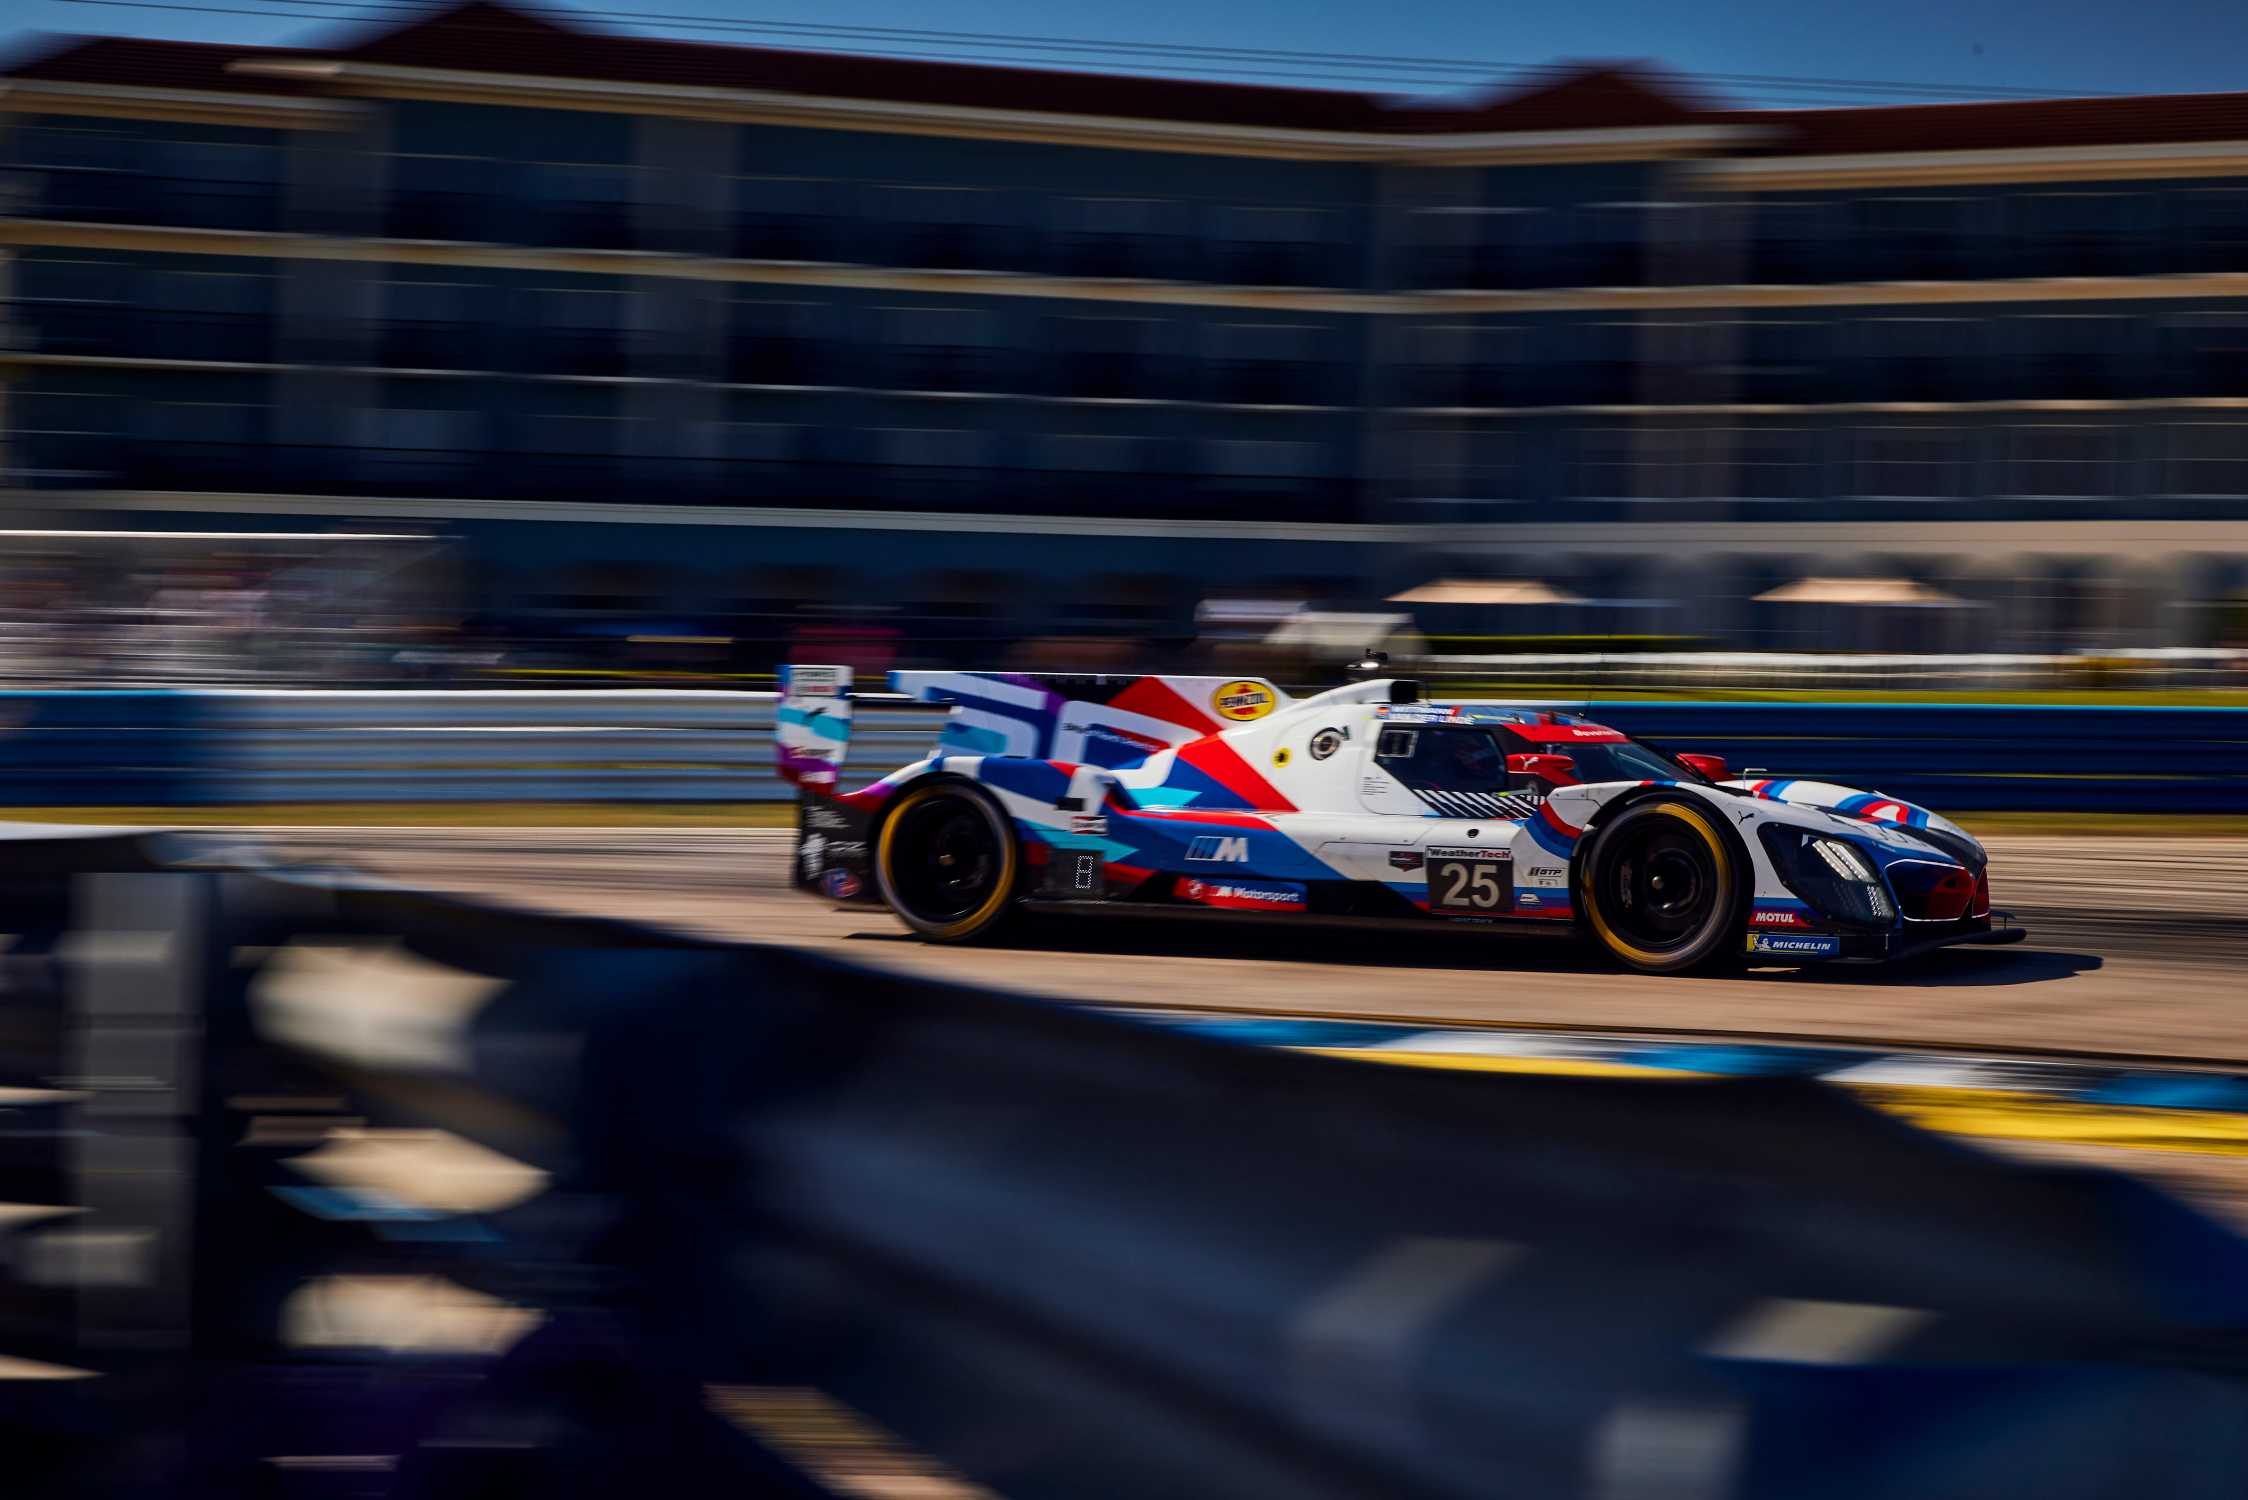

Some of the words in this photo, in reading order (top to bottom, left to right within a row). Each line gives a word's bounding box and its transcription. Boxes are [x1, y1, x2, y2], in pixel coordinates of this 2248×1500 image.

[1428, 848, 1511, 858] WeatherTech
[1439, 861, 1501, 908] 25
[1233, 886, 1300, 902] Motorsport
[1755, 912, 1794, 923] MOTUL
[1772, 940, 1831, 951] MICHELIN
